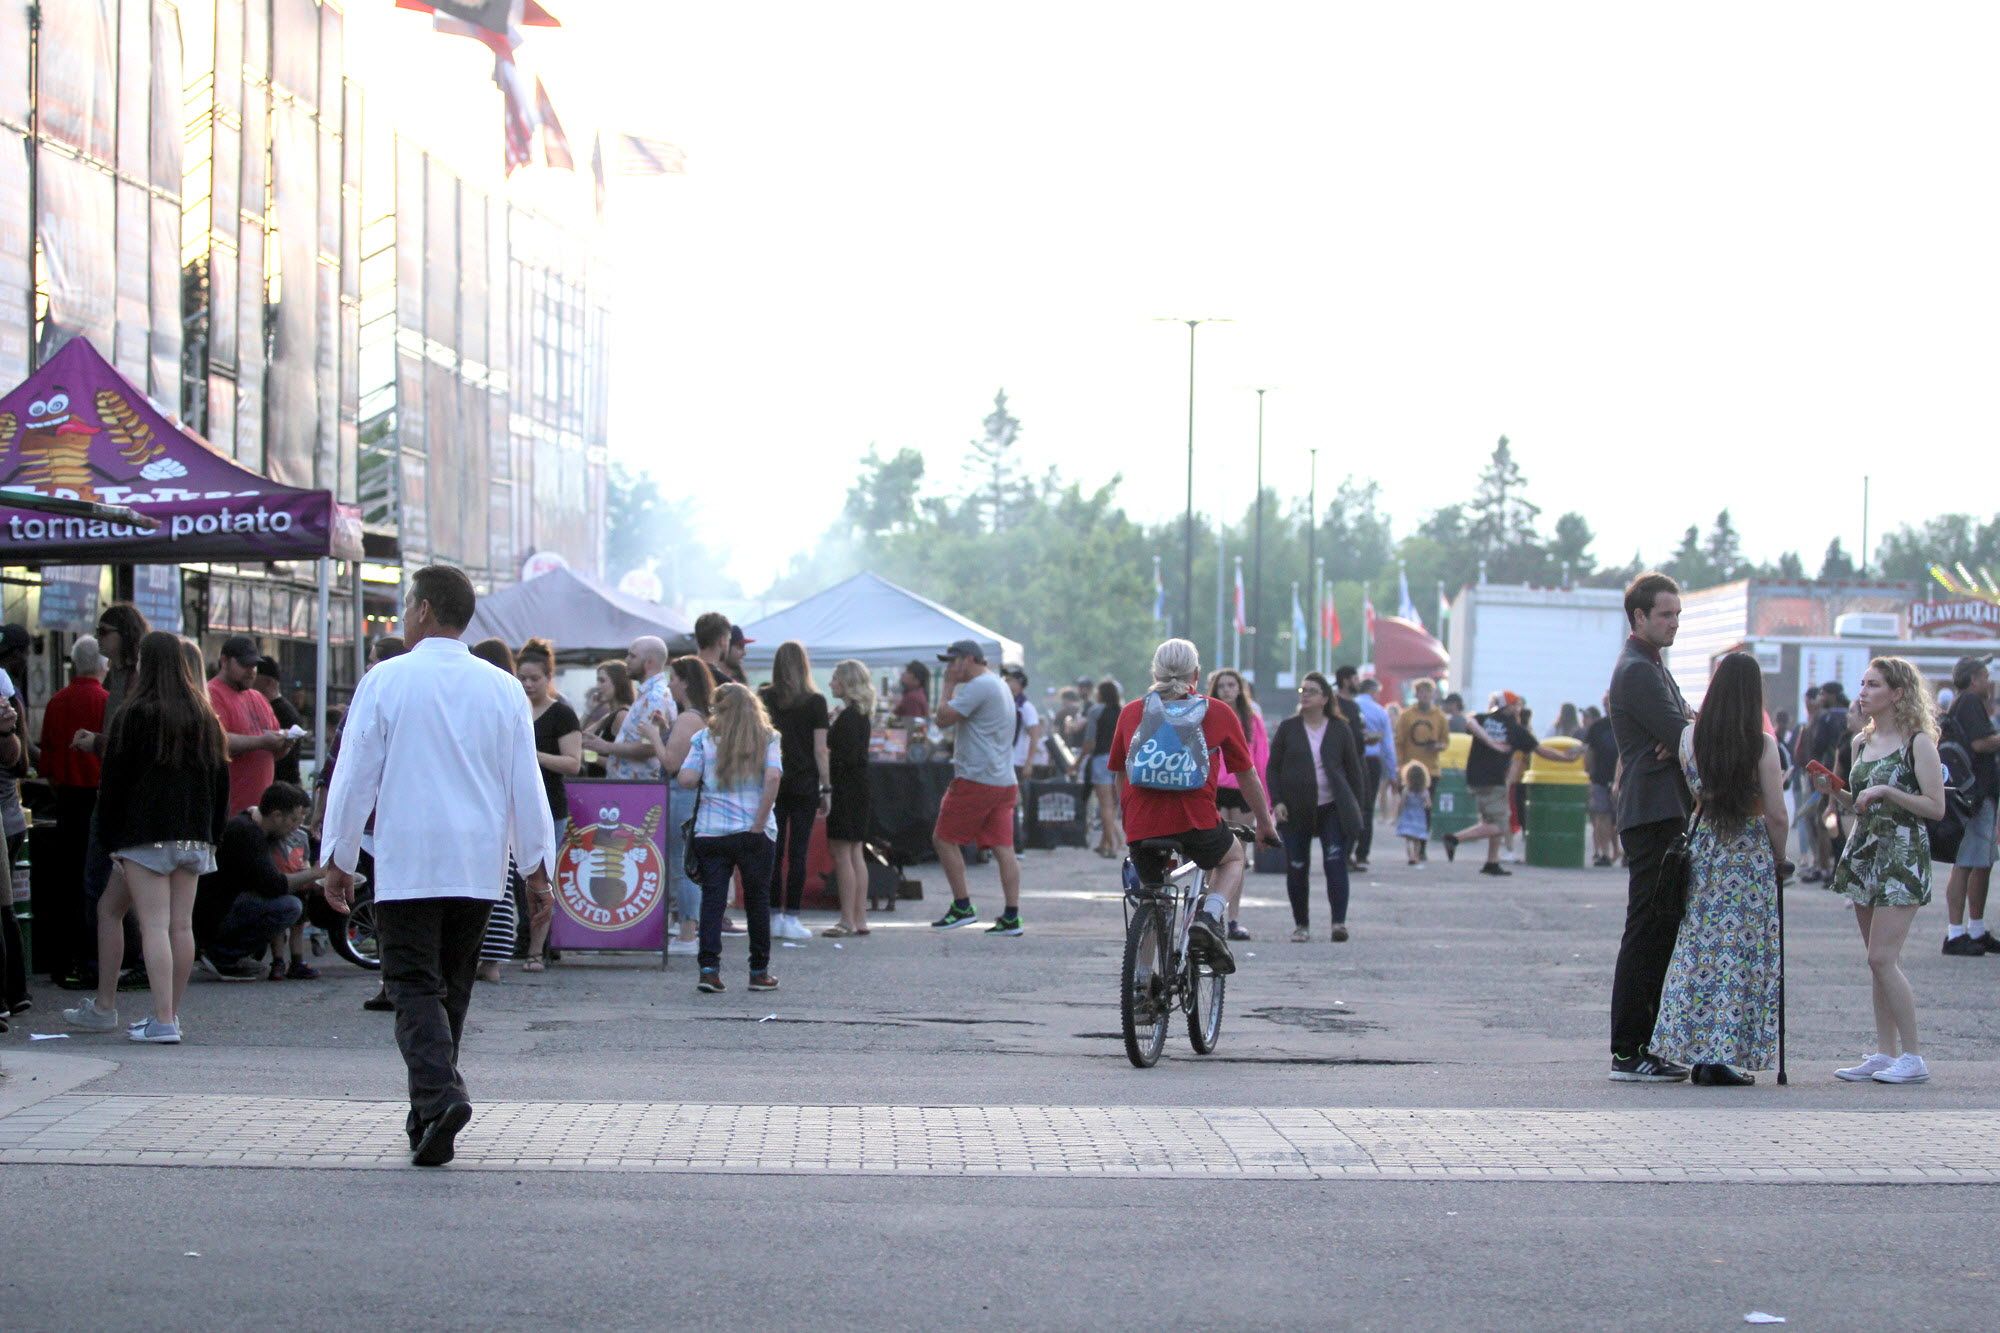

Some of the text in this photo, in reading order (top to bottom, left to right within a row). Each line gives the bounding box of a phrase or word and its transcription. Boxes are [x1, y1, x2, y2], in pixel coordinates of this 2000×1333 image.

[171, 505, 293, 541] potato
[1133, 738, 1198, 772] Coors
[1141, 768, 1192, 786] LIGHT
[560, 871, 658, 923] TWISTED TATERS
